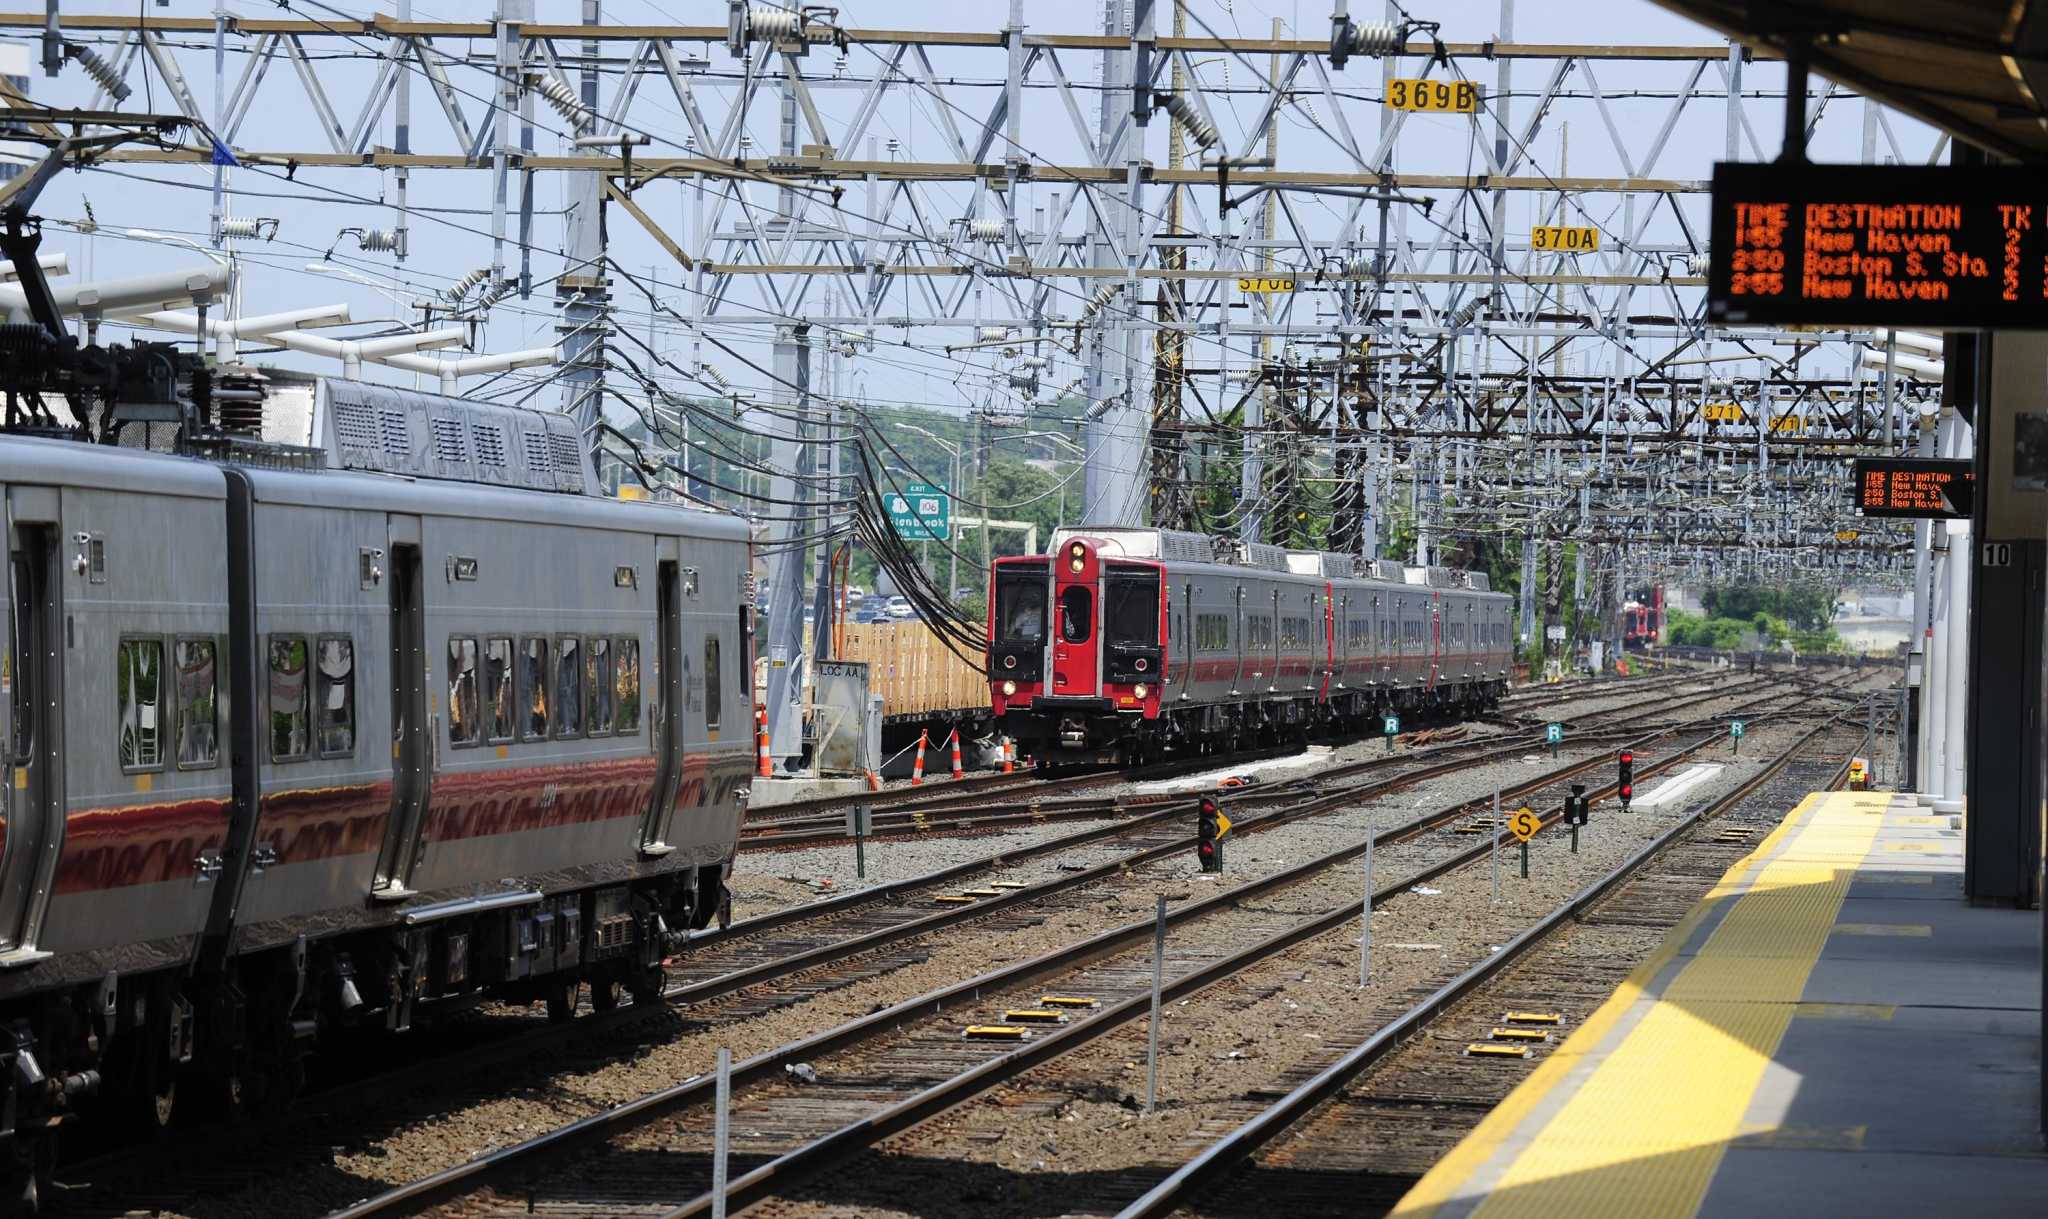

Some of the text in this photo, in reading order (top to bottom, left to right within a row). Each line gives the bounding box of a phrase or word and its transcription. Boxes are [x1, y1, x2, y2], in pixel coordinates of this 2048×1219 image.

[1391, 81, 1472, 109] 369B
[1733, 203, 2032, 229] TIME DESTINATION TK
[1536, 229, 1593, 248] 370A
[1804, 228, 1854, 251] New
[1867, 229, 1950, 251] Haven
[1803, 251, 1892, 276] Boston
[1906, 252, 1928, 276] S.
[1942, 253, 1988, 277] Sta.
[1802, 274, 1852, 298] New
[1866, 275, 1949, 299] Haven
[1865, 481, 1884, 489] 1:55
[1891, 481, 1911, 490] New
[1866, 472, 1886, 481] TIME
[1892, 472, 1951, 482] DESTINATION
[1864, 489, 1885, 497] 2:50
[1891, 490, 1925, 499] Boston
[1891, 499, 1910, 508] New
[1986, 545, 2009, 565] 10
[1386, 718, 1397, 731] R
[1548, 726, 1560, 740] R
[1731, 721, 1742, 735] R
[1517, 813, 1532, 836] S
